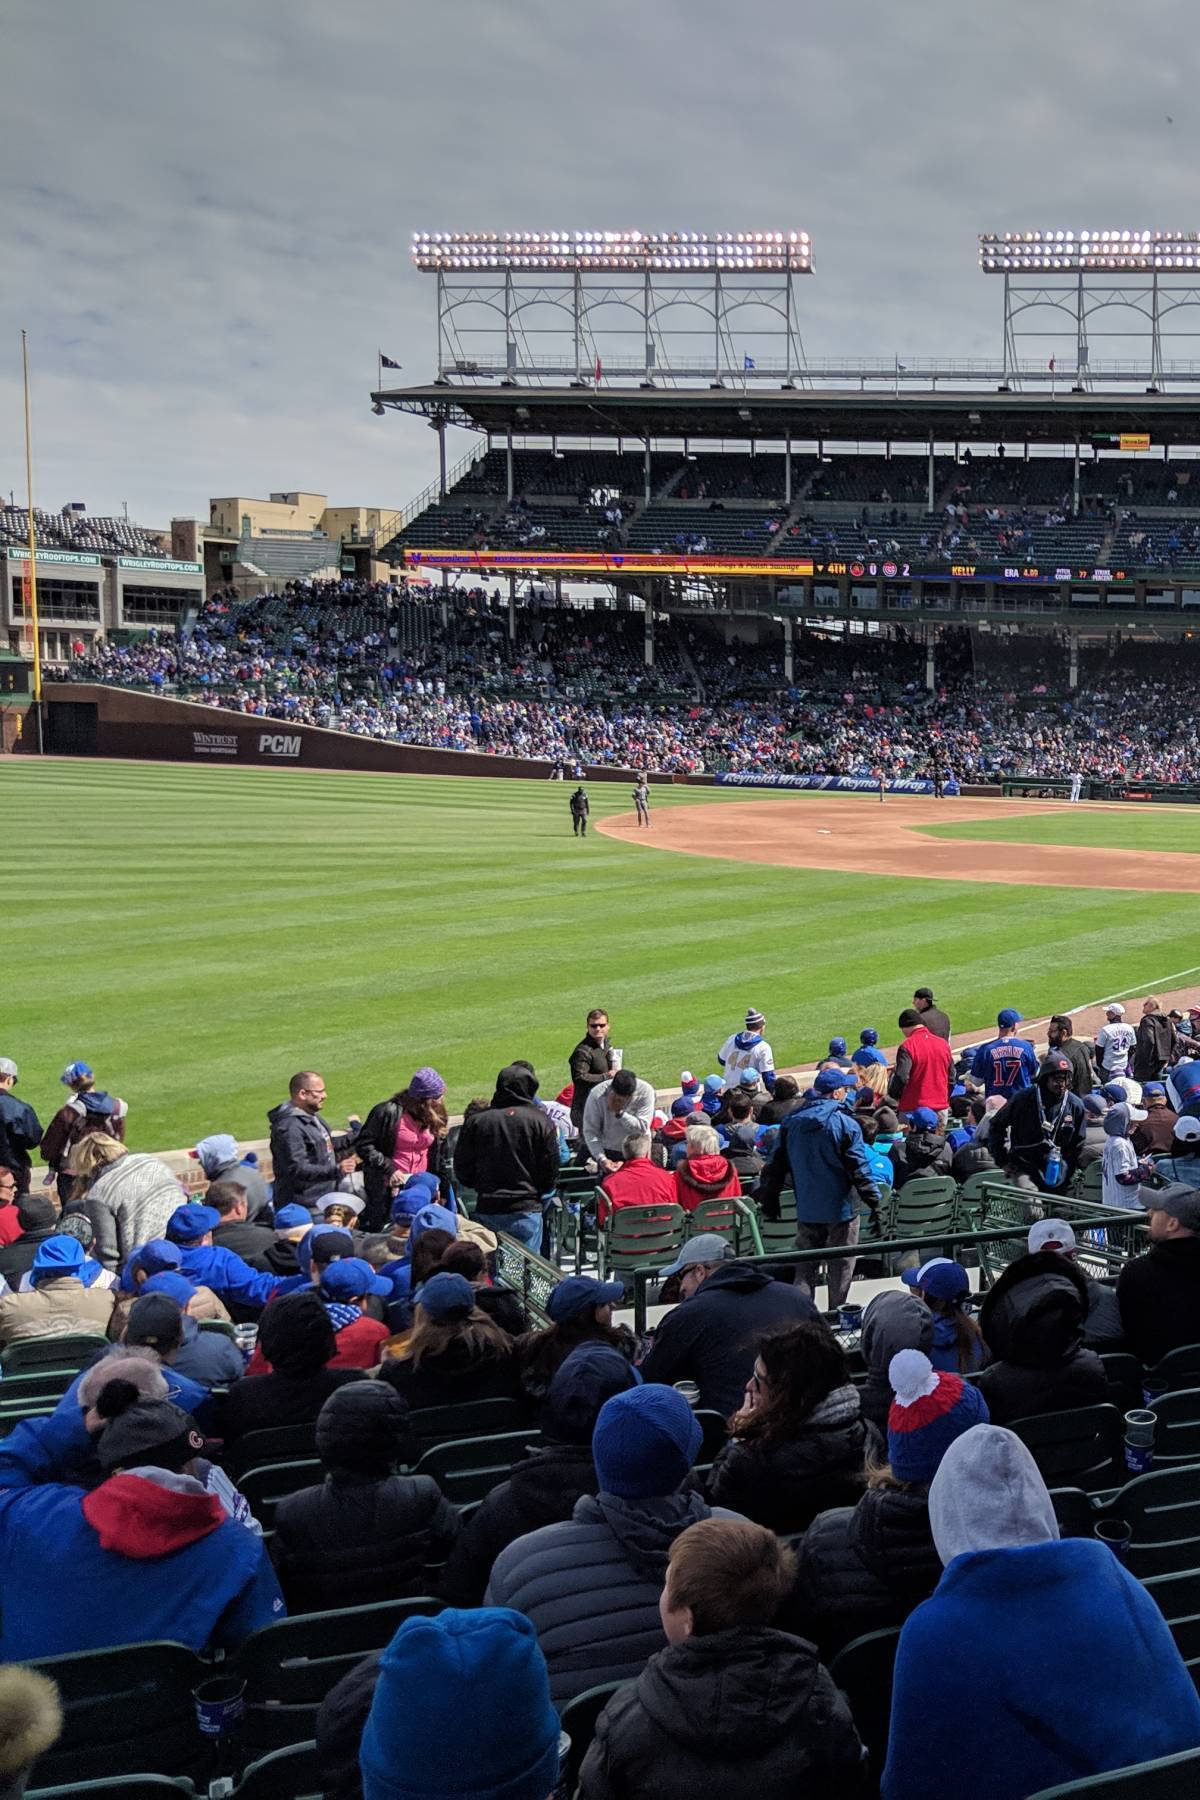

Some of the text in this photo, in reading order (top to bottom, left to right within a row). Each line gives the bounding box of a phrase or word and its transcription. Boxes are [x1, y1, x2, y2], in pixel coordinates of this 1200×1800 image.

[13, 550, 97, 564] WRIGEYROOFTOPS.COM
[827, 563, 910, 576] 4TH 0 2
[952, 565, 976, 577] KELLY
[1004, 568, 1020, 578] ERA
[259, 735, 302, 754] PCM
[723, 772, 811, 788] Reynolds Wrap
[838, 776, 926, 792] Reynols Wrap
[1112, 1038, 1128, 1051] 34
[993, 1060, 1022, 1087] 17
